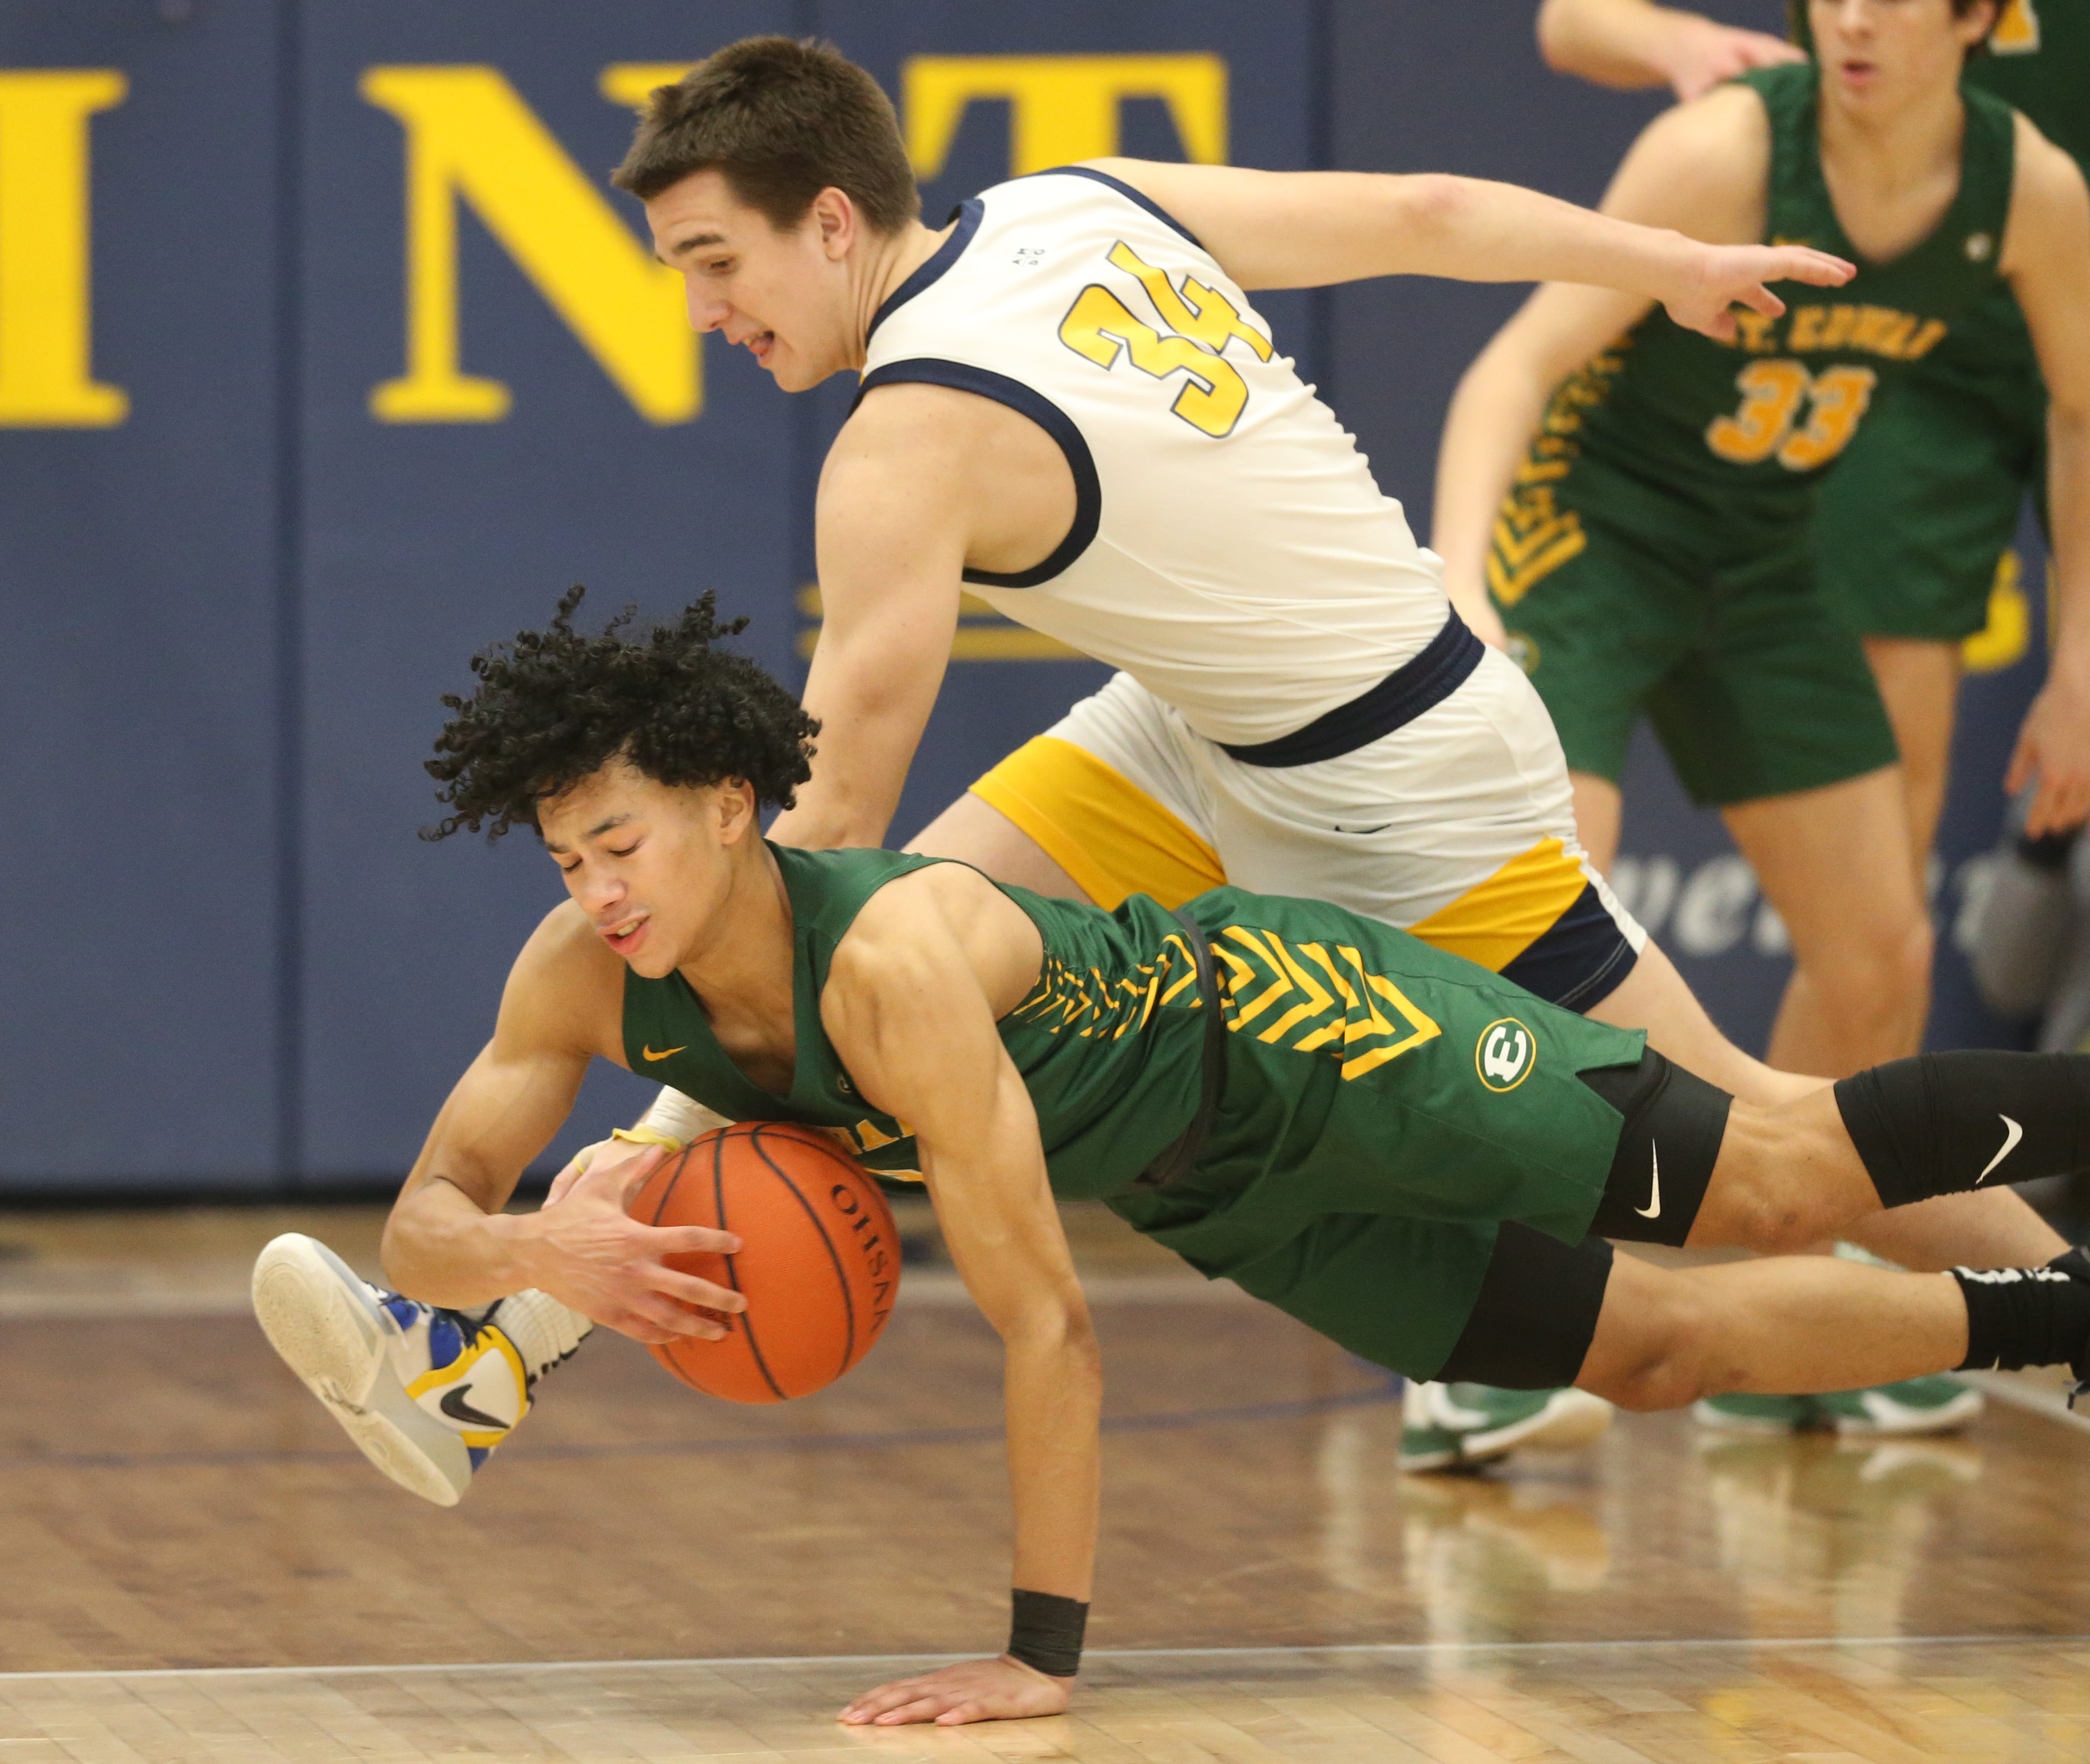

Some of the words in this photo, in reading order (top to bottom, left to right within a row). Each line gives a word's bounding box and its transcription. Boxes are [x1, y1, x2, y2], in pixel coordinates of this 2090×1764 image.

[1058, 240, 1274, 438] 34
[1706, 358, 1878, 471] 33
[1484, 1026, 1528, 1082] E
